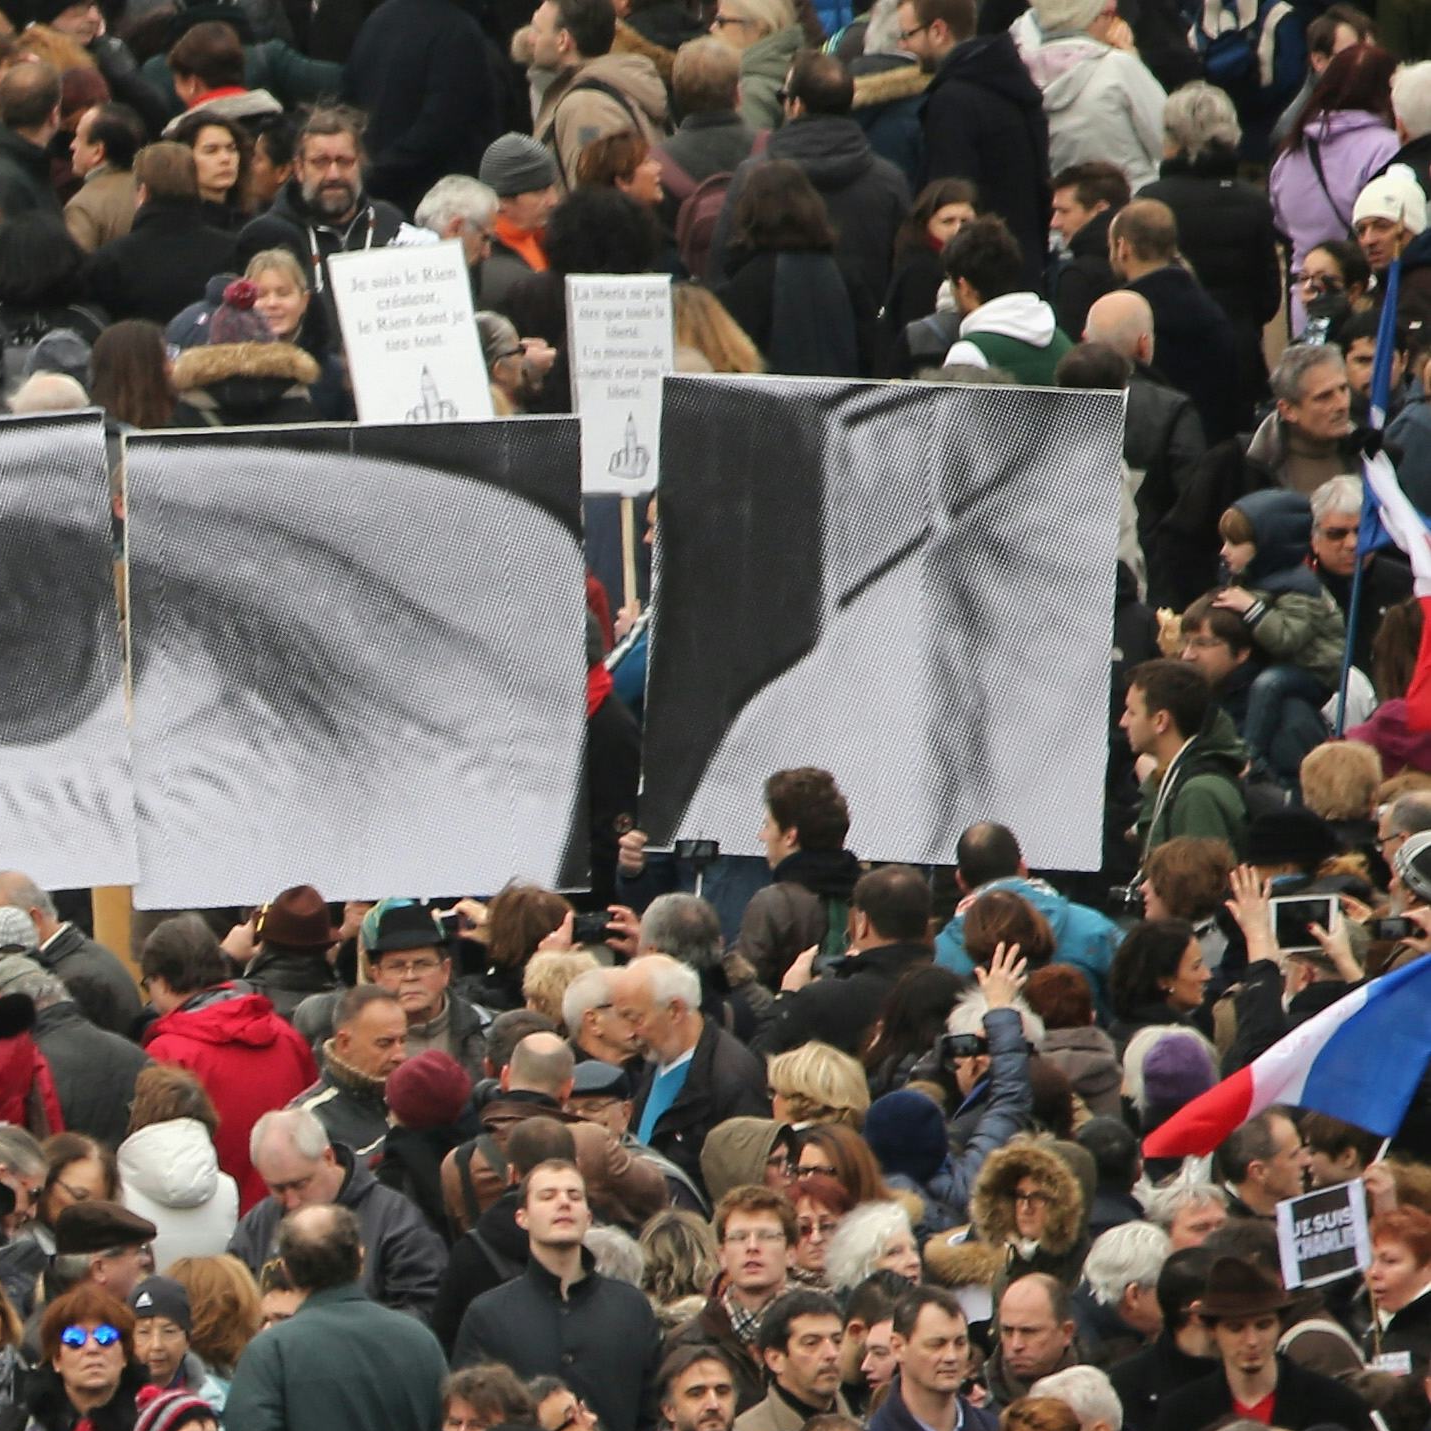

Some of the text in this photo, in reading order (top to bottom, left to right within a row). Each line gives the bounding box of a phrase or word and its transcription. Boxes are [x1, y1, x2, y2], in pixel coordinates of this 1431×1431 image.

[351, 267, 457, 292] Je suis le Rien
[358, 310, 466, 334] le Rien dont je
[1294, 1228, 1355, 1259] CHARLIE
